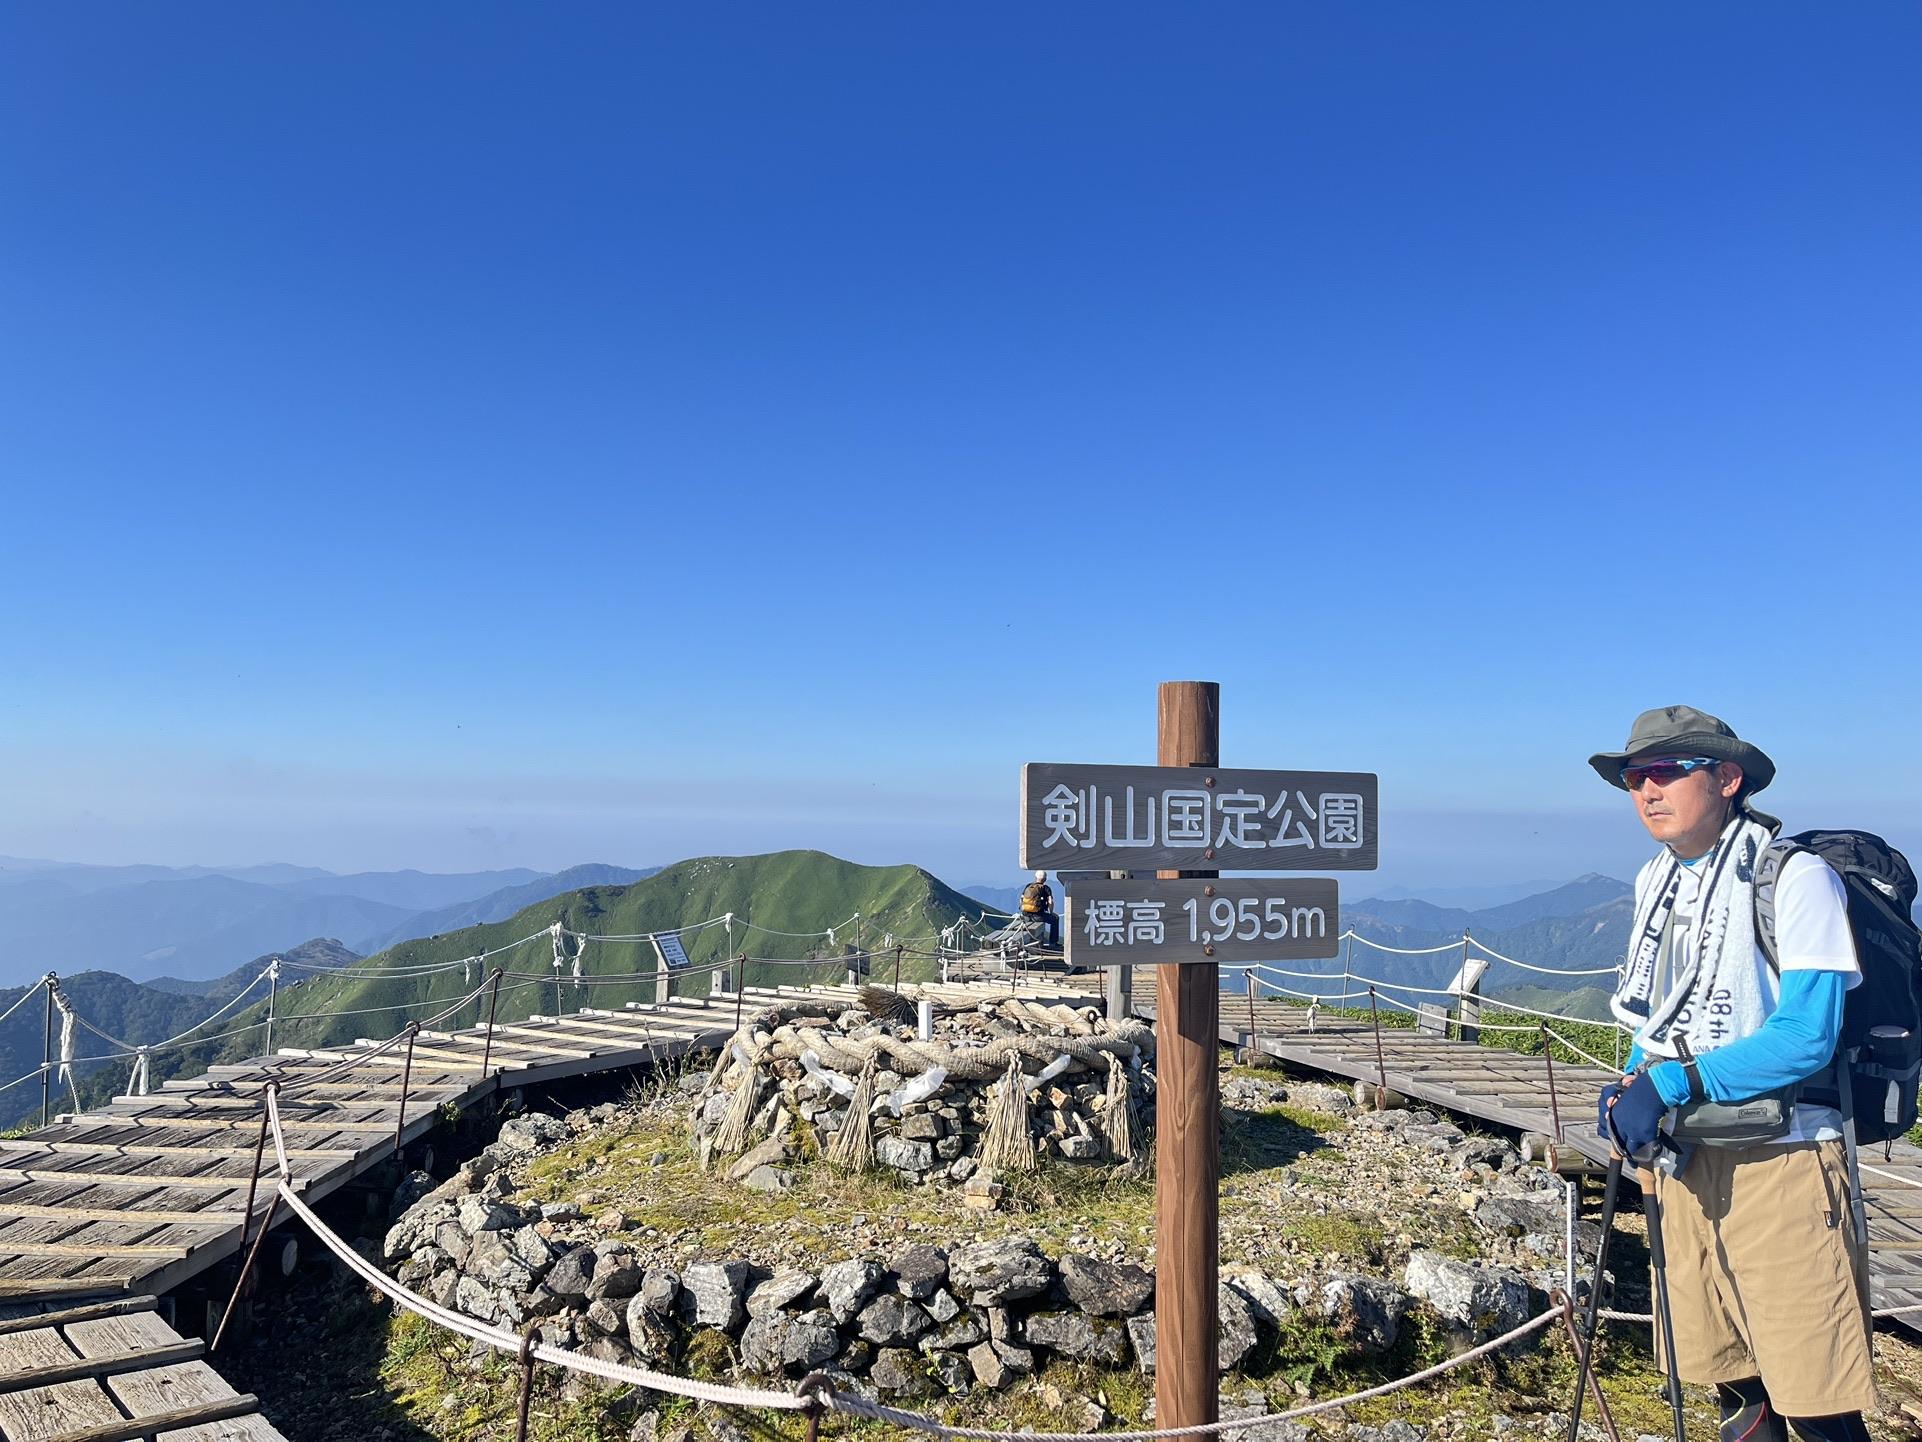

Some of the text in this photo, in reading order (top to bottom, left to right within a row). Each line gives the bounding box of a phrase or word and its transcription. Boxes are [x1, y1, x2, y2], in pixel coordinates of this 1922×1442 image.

[1041, 783, 1364, 850] 剣山国定公園
[1084, 897, 1326, 946] 標高 1,955m
